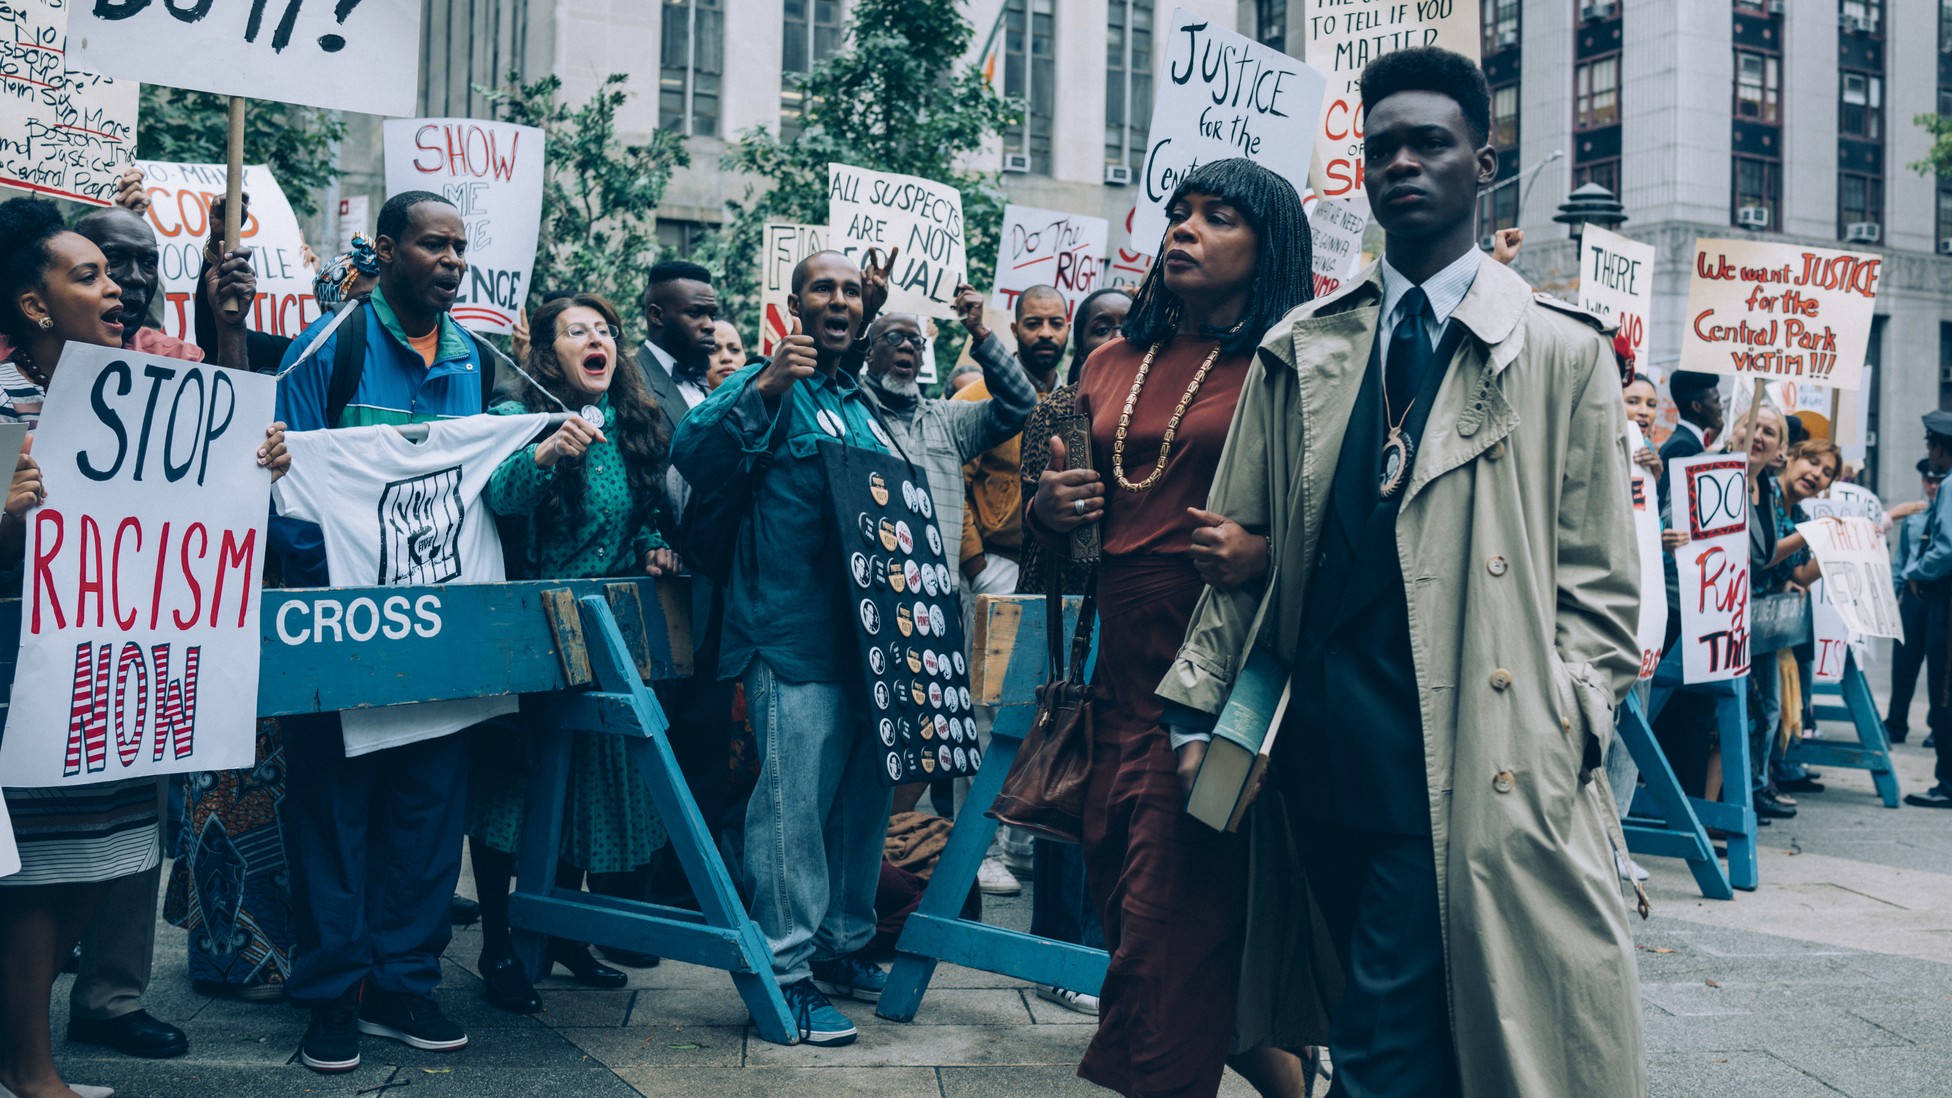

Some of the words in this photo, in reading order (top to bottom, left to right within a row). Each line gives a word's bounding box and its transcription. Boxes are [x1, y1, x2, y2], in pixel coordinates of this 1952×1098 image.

[1311, 15, 1336, 41] TO
[1344, 10, 1382, 34] TELL
[1390, 4, 1408, 25] IF
[1416, 0, 1453, 22] YOU
[413, 124, 519, 183] SHOW
[829, 171, 860, 204] ALL
[869, 179, 961, 238] SUSPECTS
[847, 213, 887, 243] ARE
[906, 222, 960, 266] NOT
[1591, 246, 1641, 296] THERE
[1697, 251, 1736, 281] We
[1740, 264, 1793, 284] want
[1794, 253, 1881, 298] JUSTICE
[1745, 285, 1779, 313] for
[1780, 289, 1820, 317] the
[1619, 311, 1643, 348] NO
[1693, 309, 1778, 346] Central
[1784, 318, 1837, 352] Park
[76, 360, 235, 487] STOP
[1697, 471, 1745, 529] DO
[30, 508, 257, 635] RACISM
[276, 594, 443, 646] CROSS
[63, 641, 201, 778] NOW
